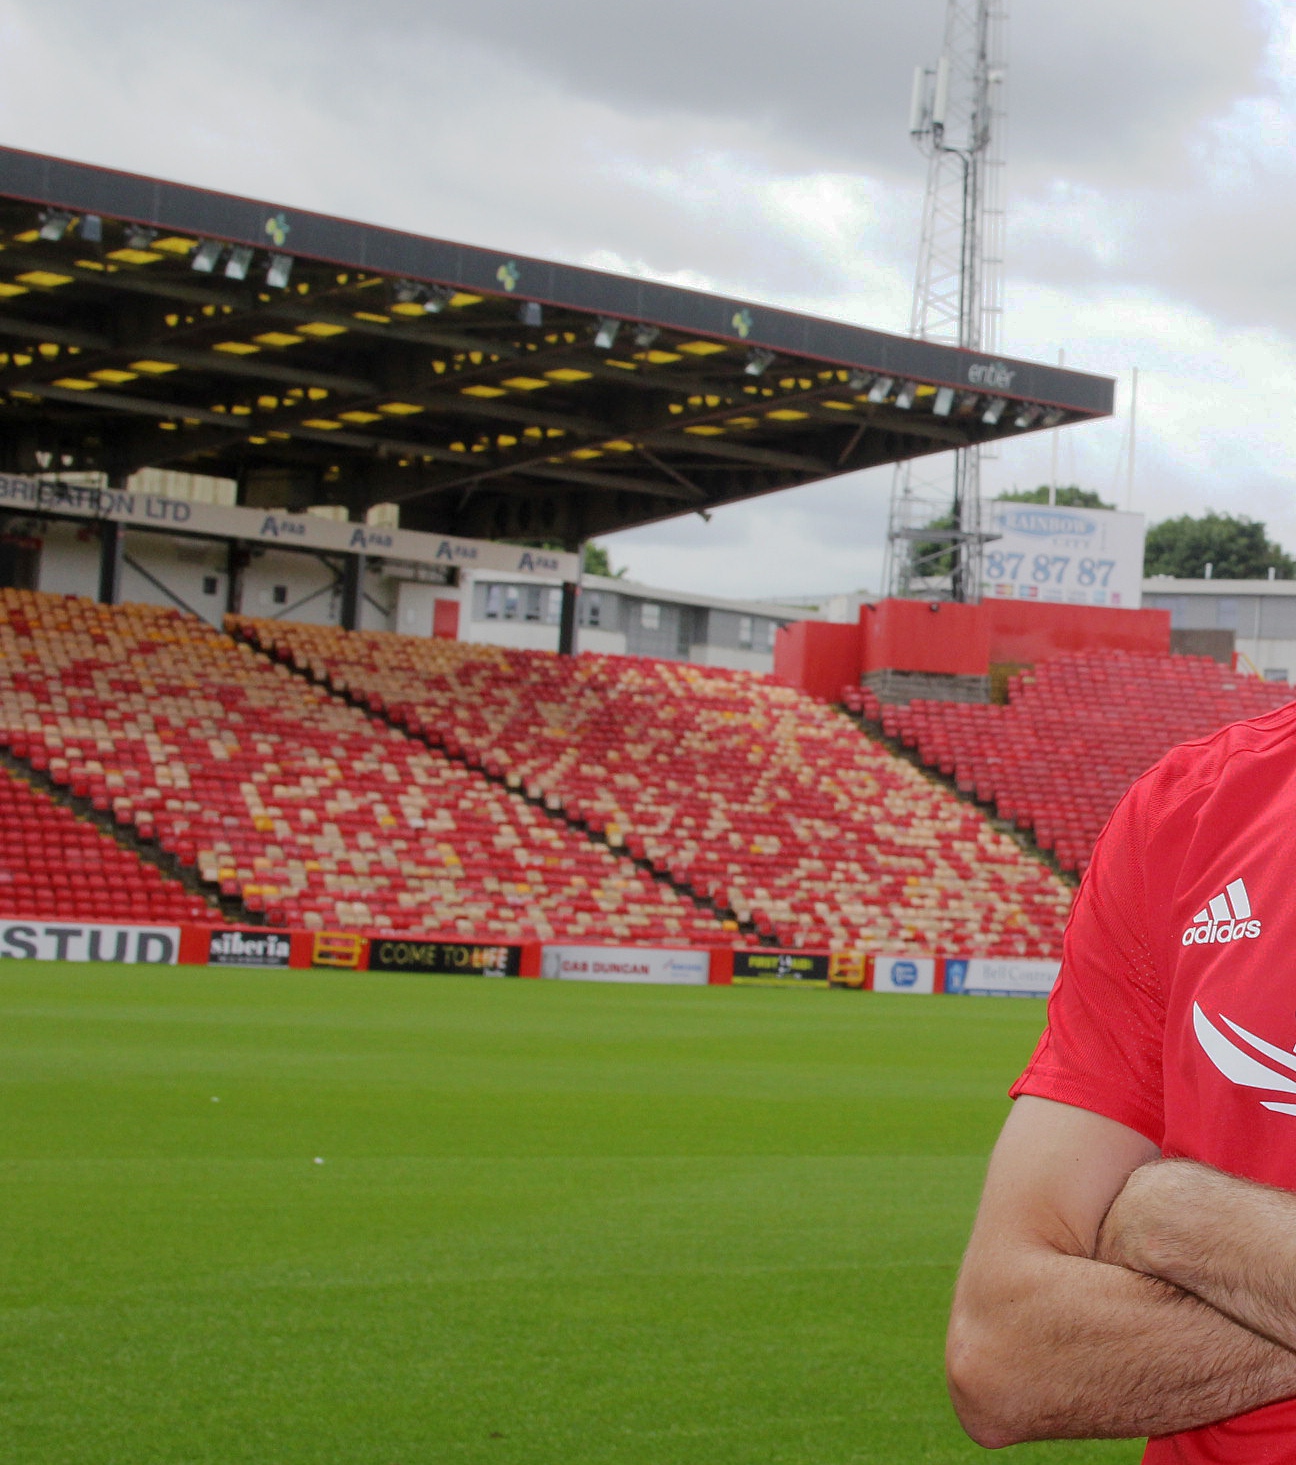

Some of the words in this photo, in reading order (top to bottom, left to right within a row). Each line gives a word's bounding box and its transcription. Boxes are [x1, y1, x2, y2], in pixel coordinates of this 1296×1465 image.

[146, 498, 191, 522] LTD
[1007, 512, 1087, 534] RAINBOW
[986, 550, 1025, 580] 87
[1032, 553, 1070, 584] 87
[1077, 556, 1116, 587] 87
[0, 925, 174, 964] STUD
[1181, 916, 1261, 947] adidas
[380, 942, 437, 966] COME
[442, 945, 470, 967] TO
[471, 946, 509, 970] LIFE
